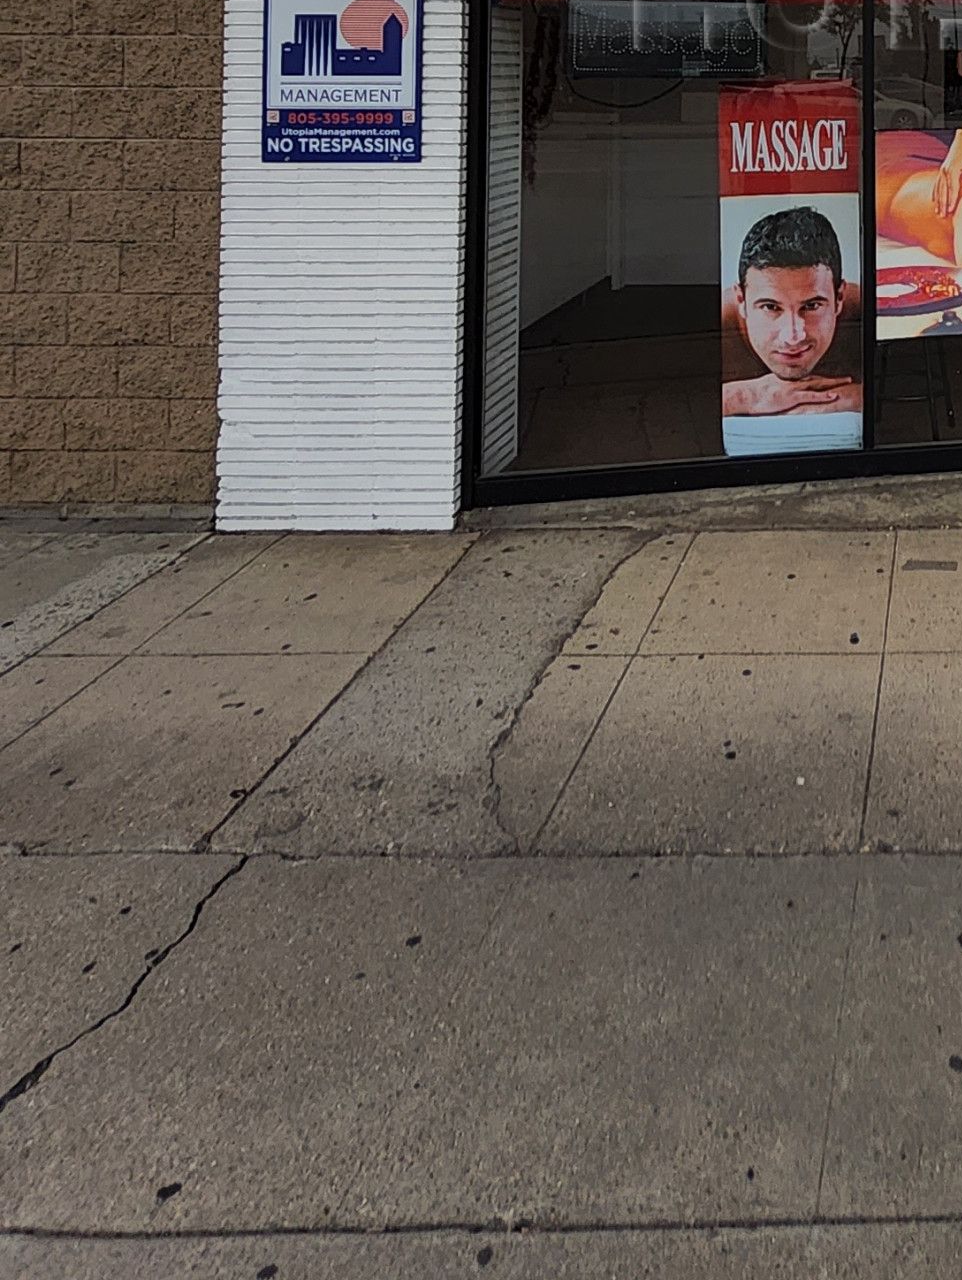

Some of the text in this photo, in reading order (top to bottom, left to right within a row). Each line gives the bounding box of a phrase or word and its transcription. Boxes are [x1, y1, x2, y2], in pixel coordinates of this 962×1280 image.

[279, 88, 403, 103] MANAGEMENT
[287, 112, 394, 125] 805-395-9999
[281, 127, 401, 137] UtopiaManagement.com
[266, 137, 415, 153] NO TRESPASSING
[729, 119, 848, 173] MASSAGE
